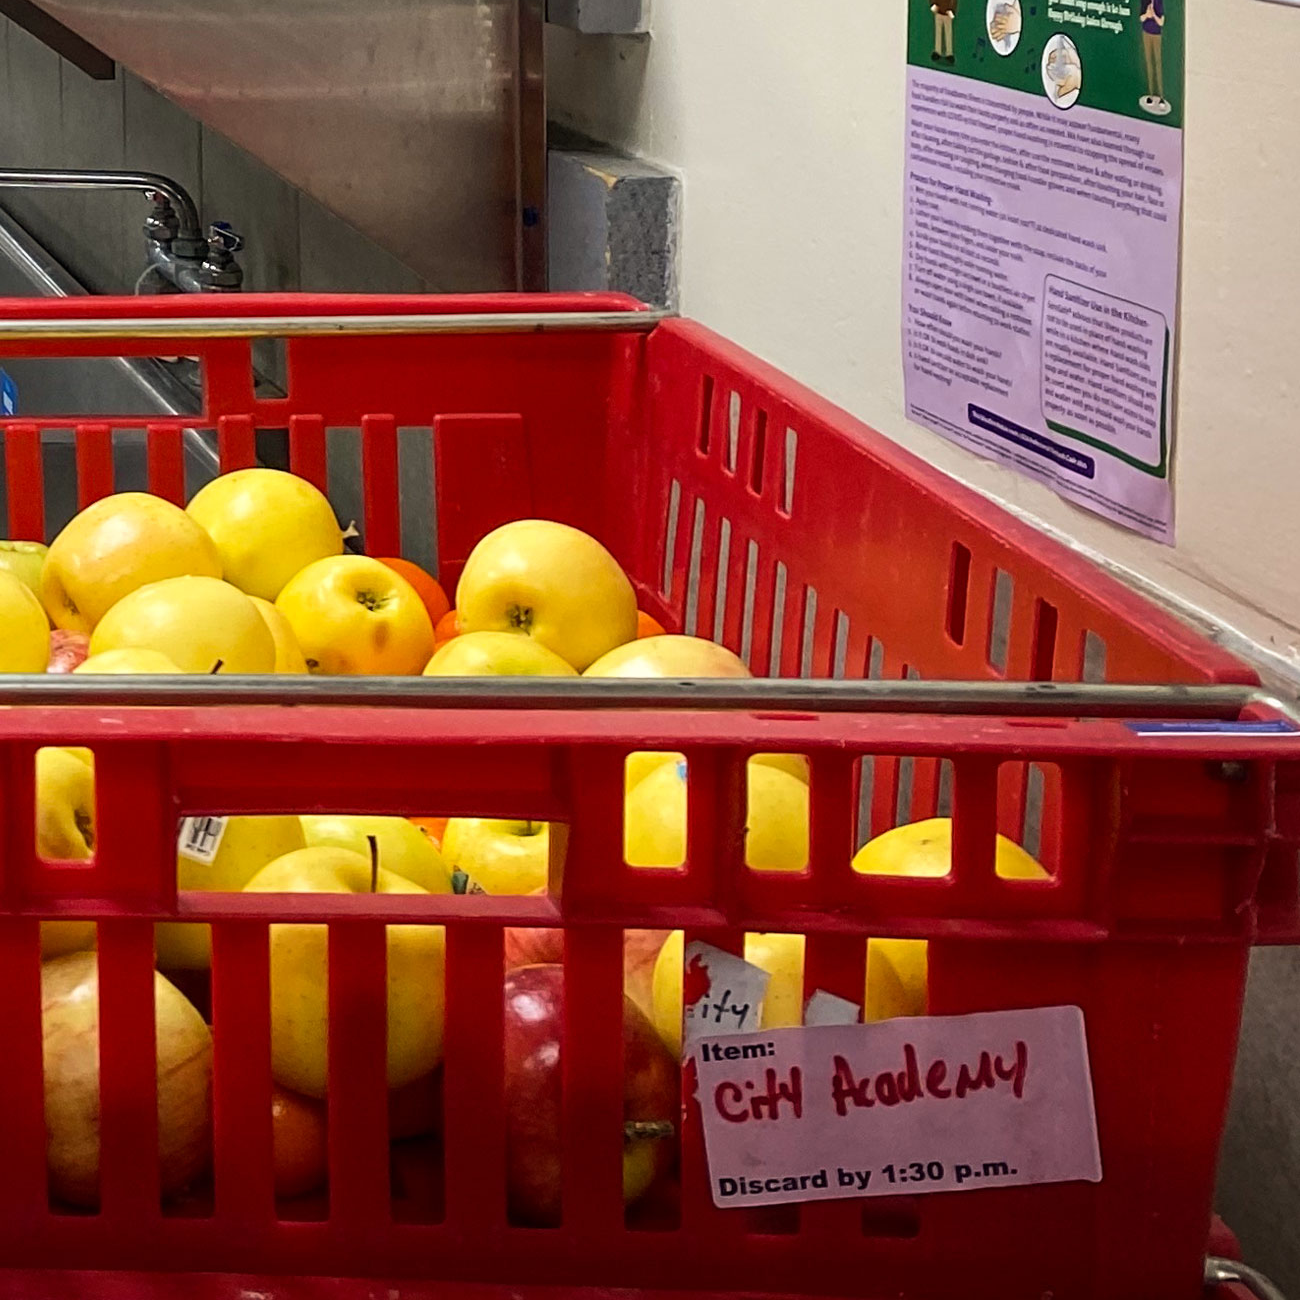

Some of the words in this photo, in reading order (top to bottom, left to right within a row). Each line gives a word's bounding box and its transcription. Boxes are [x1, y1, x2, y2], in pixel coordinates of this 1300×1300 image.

[687, 989, 750, 1029] ity
[702, 1041, 776, 1064] Item:
[714, 1067, 804, 1123] City
[718, 1169, 829, 1198] Discard
[838, 1168, 872, 1190] by
[881, 1162, 944, 1184] 1:30
[954, 1160, 1018, 1184] p.m.
